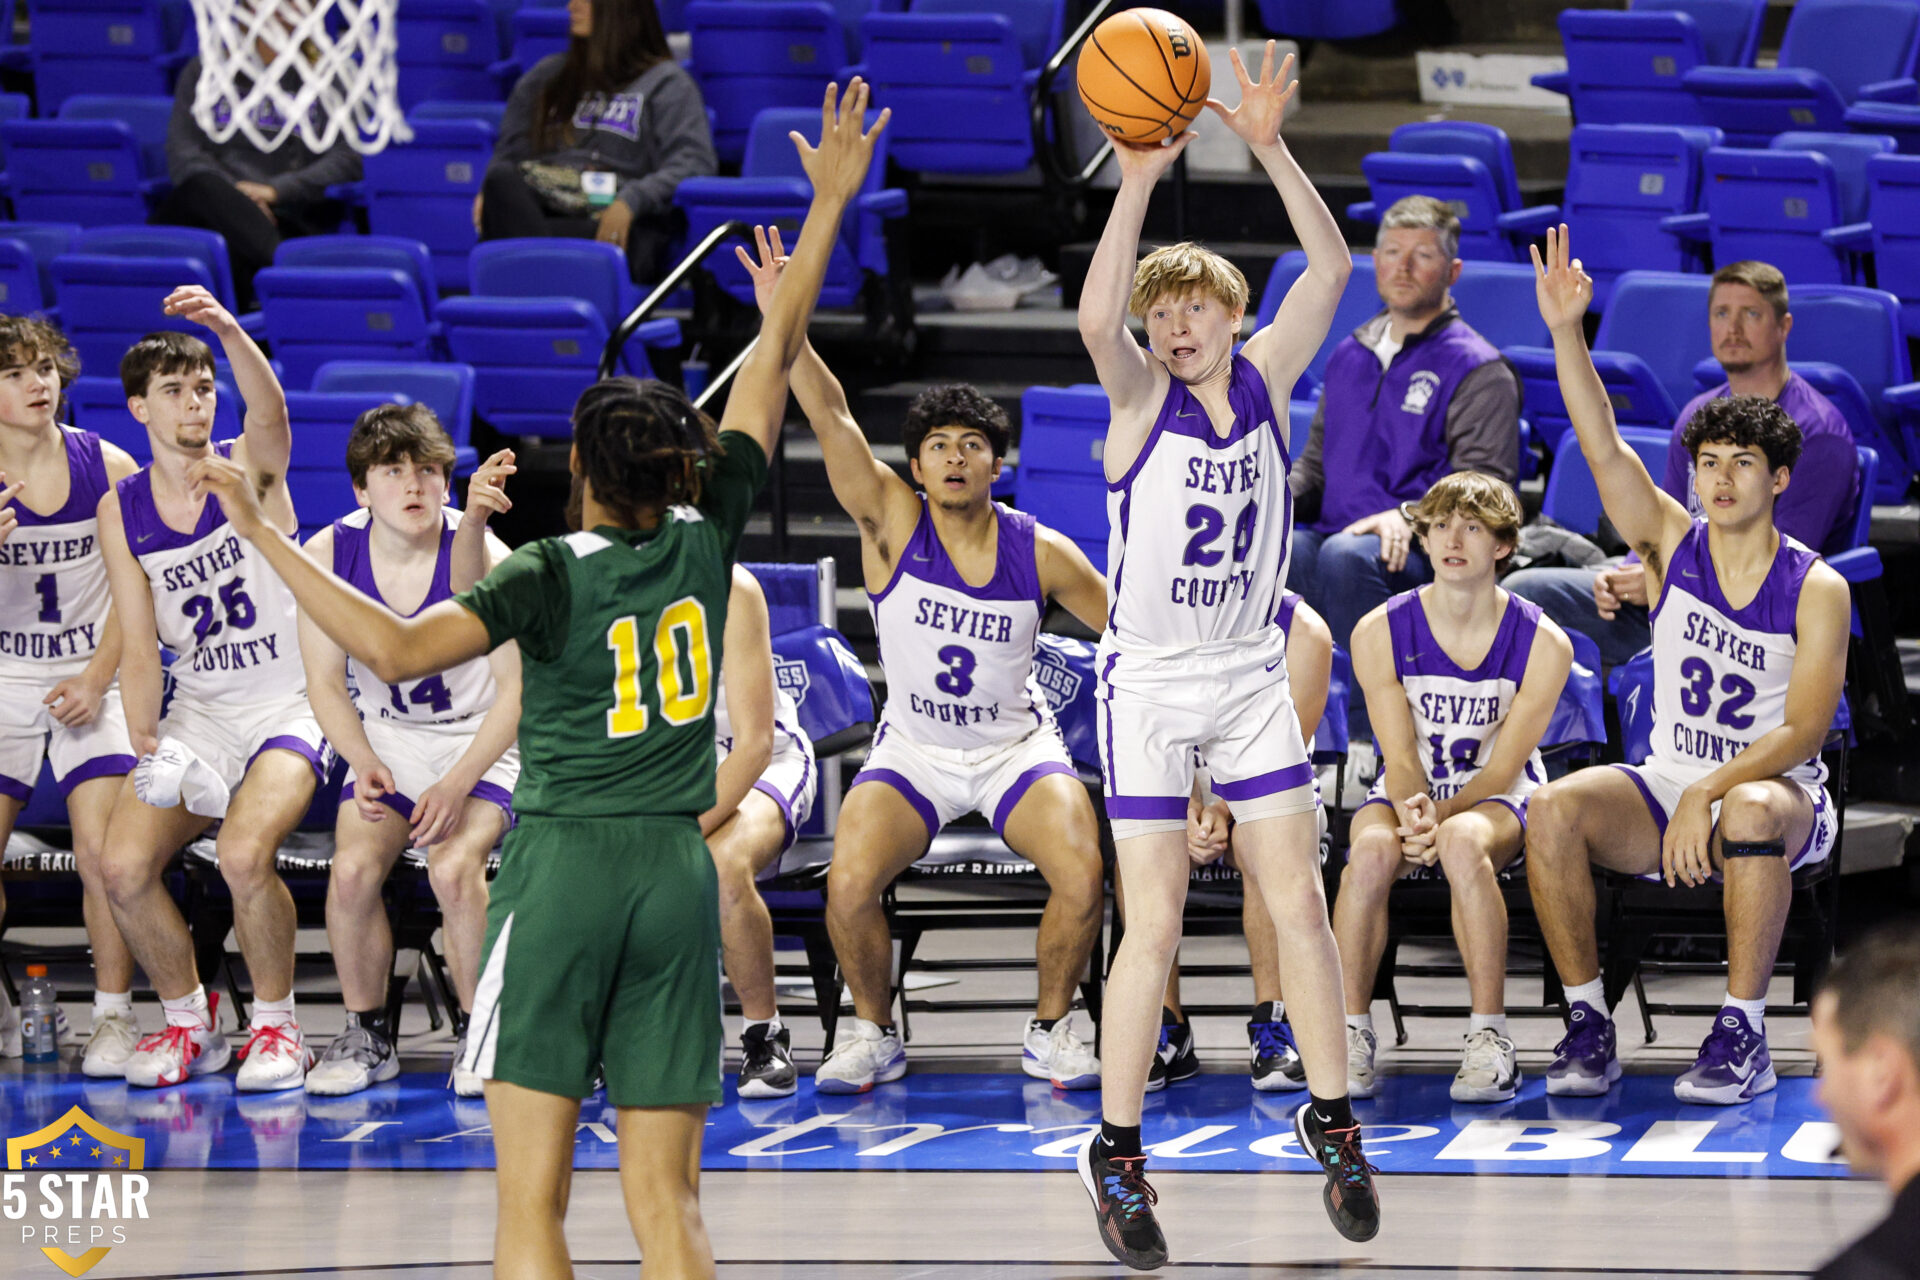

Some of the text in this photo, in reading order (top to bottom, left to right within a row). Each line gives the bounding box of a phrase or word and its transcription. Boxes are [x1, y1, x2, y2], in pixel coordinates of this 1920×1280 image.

[0, 535, 94, 566] SEVIER
[163, 536, 244, 592] SEVIER
[35, 573, 62, 624] 1
[181, 576, 257, 646] 25
[915, 597, 1012, 642] SEVIER
[0, 622, 96, 658] COUNTY
[193, 633, 279, 672] COUNTY
[1681, 611, 1766, 671] SEVIER
[607, 595, 713, 739] 10
[935, 644, 978, 698] 3
[910, 693, 999, 726] COUNTY
[1420, 692, 1500, 726] SEVIER
[1680, 656, 1756, 731] 32
[21, 1017, 35, 1037] G
